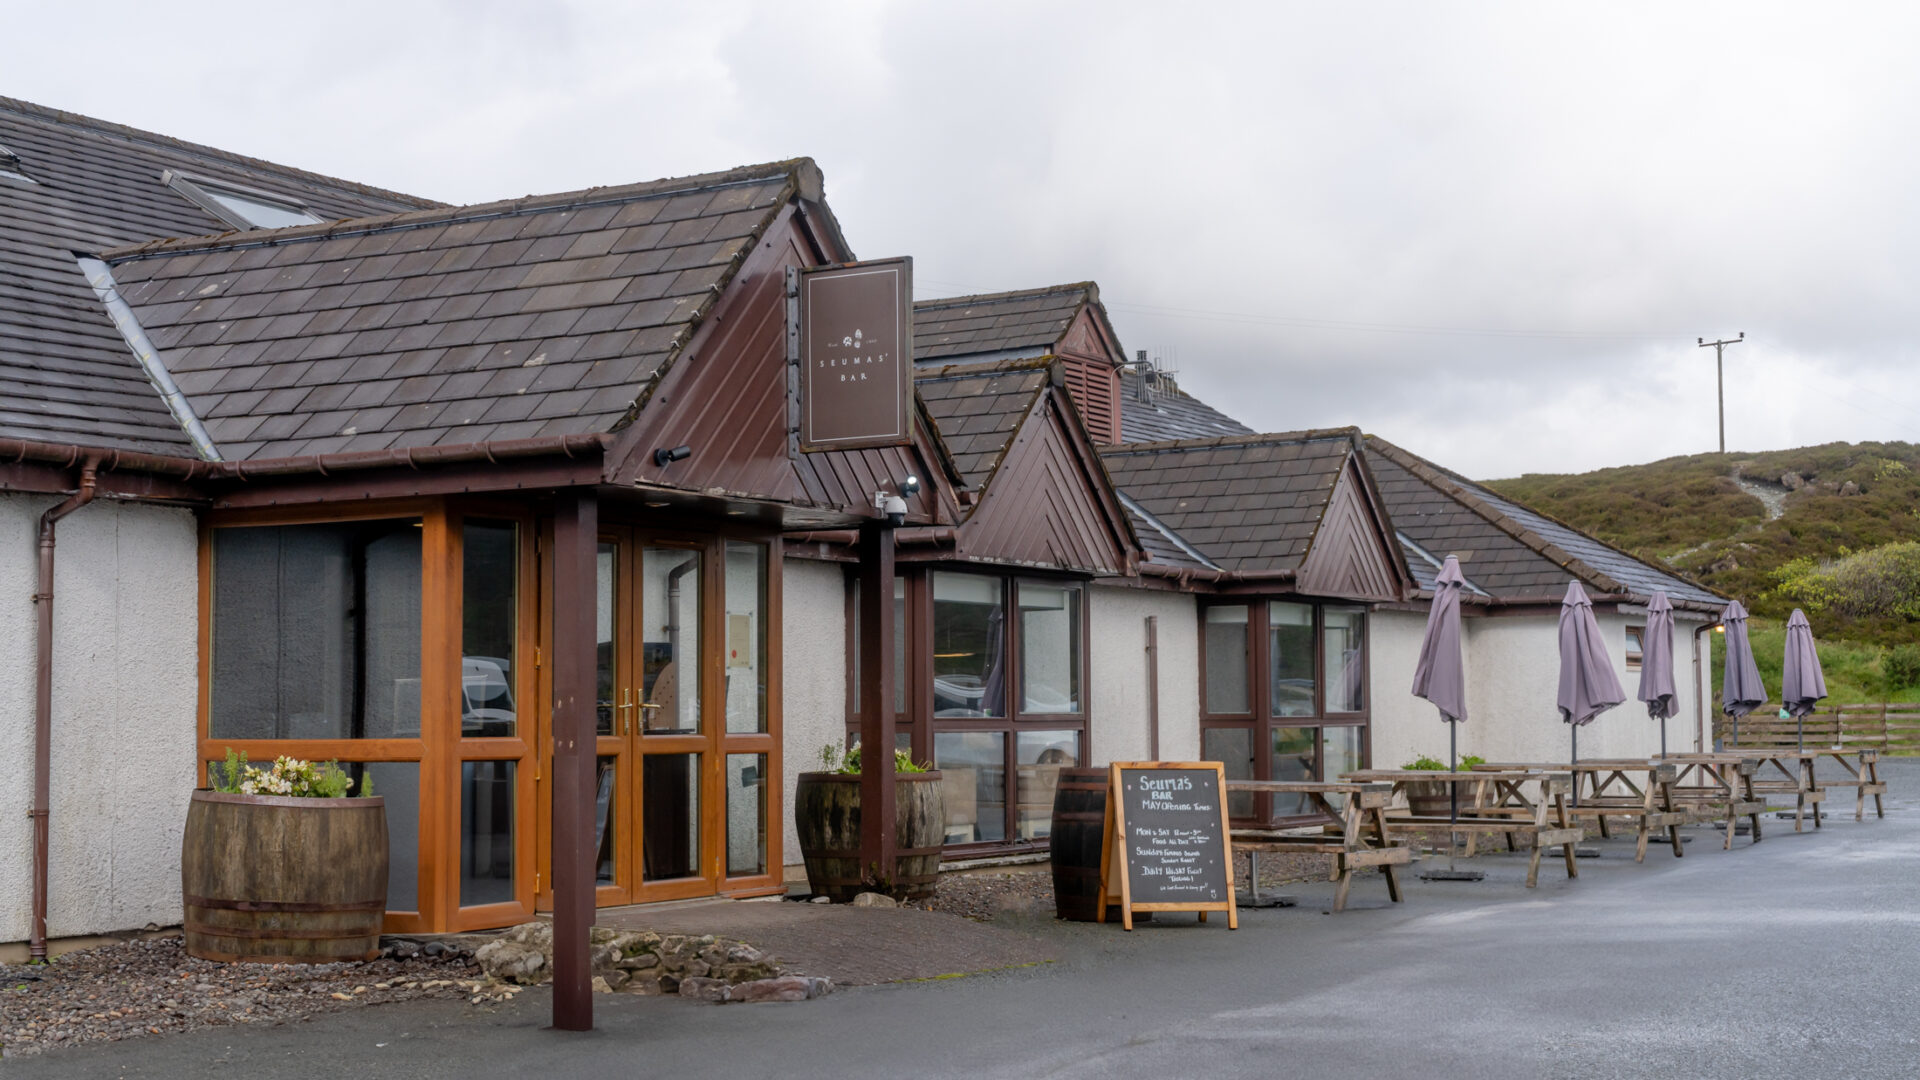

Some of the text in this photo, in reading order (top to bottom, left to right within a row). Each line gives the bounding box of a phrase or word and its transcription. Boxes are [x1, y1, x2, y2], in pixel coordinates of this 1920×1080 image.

[820, 353, 888, 368] SEUMAS'
[841, 373, 867, 382] BAR
[1151, 791, 1173, 800] BAR
[1142, 800, 1161, 811] MAY
